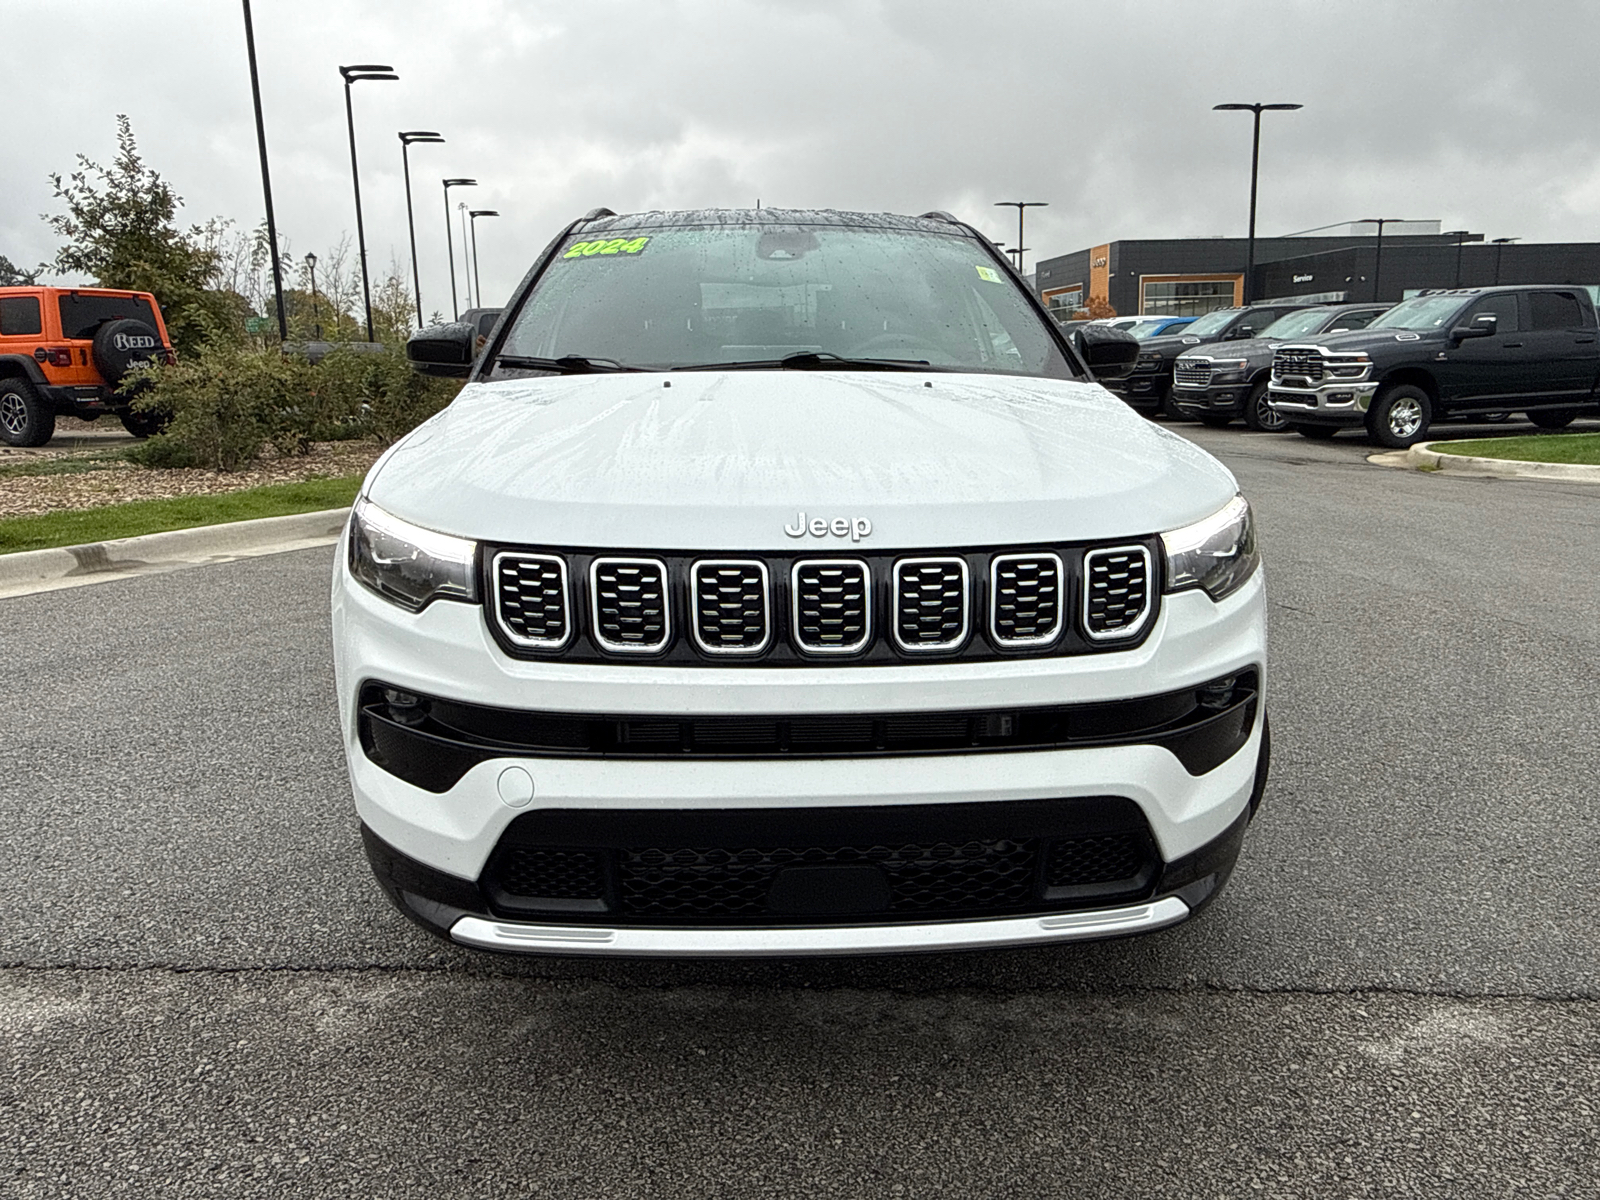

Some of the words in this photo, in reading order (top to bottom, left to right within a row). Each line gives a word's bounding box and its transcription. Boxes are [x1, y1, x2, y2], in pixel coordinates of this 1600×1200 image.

[562, 236, 650, 259] 2024
[1292, 273, 1314, 284] Service
[113, 332, 155, 352] REED
[126, 358, 151, 370] Jeep
[783, 511, 873, 543] Jeep
